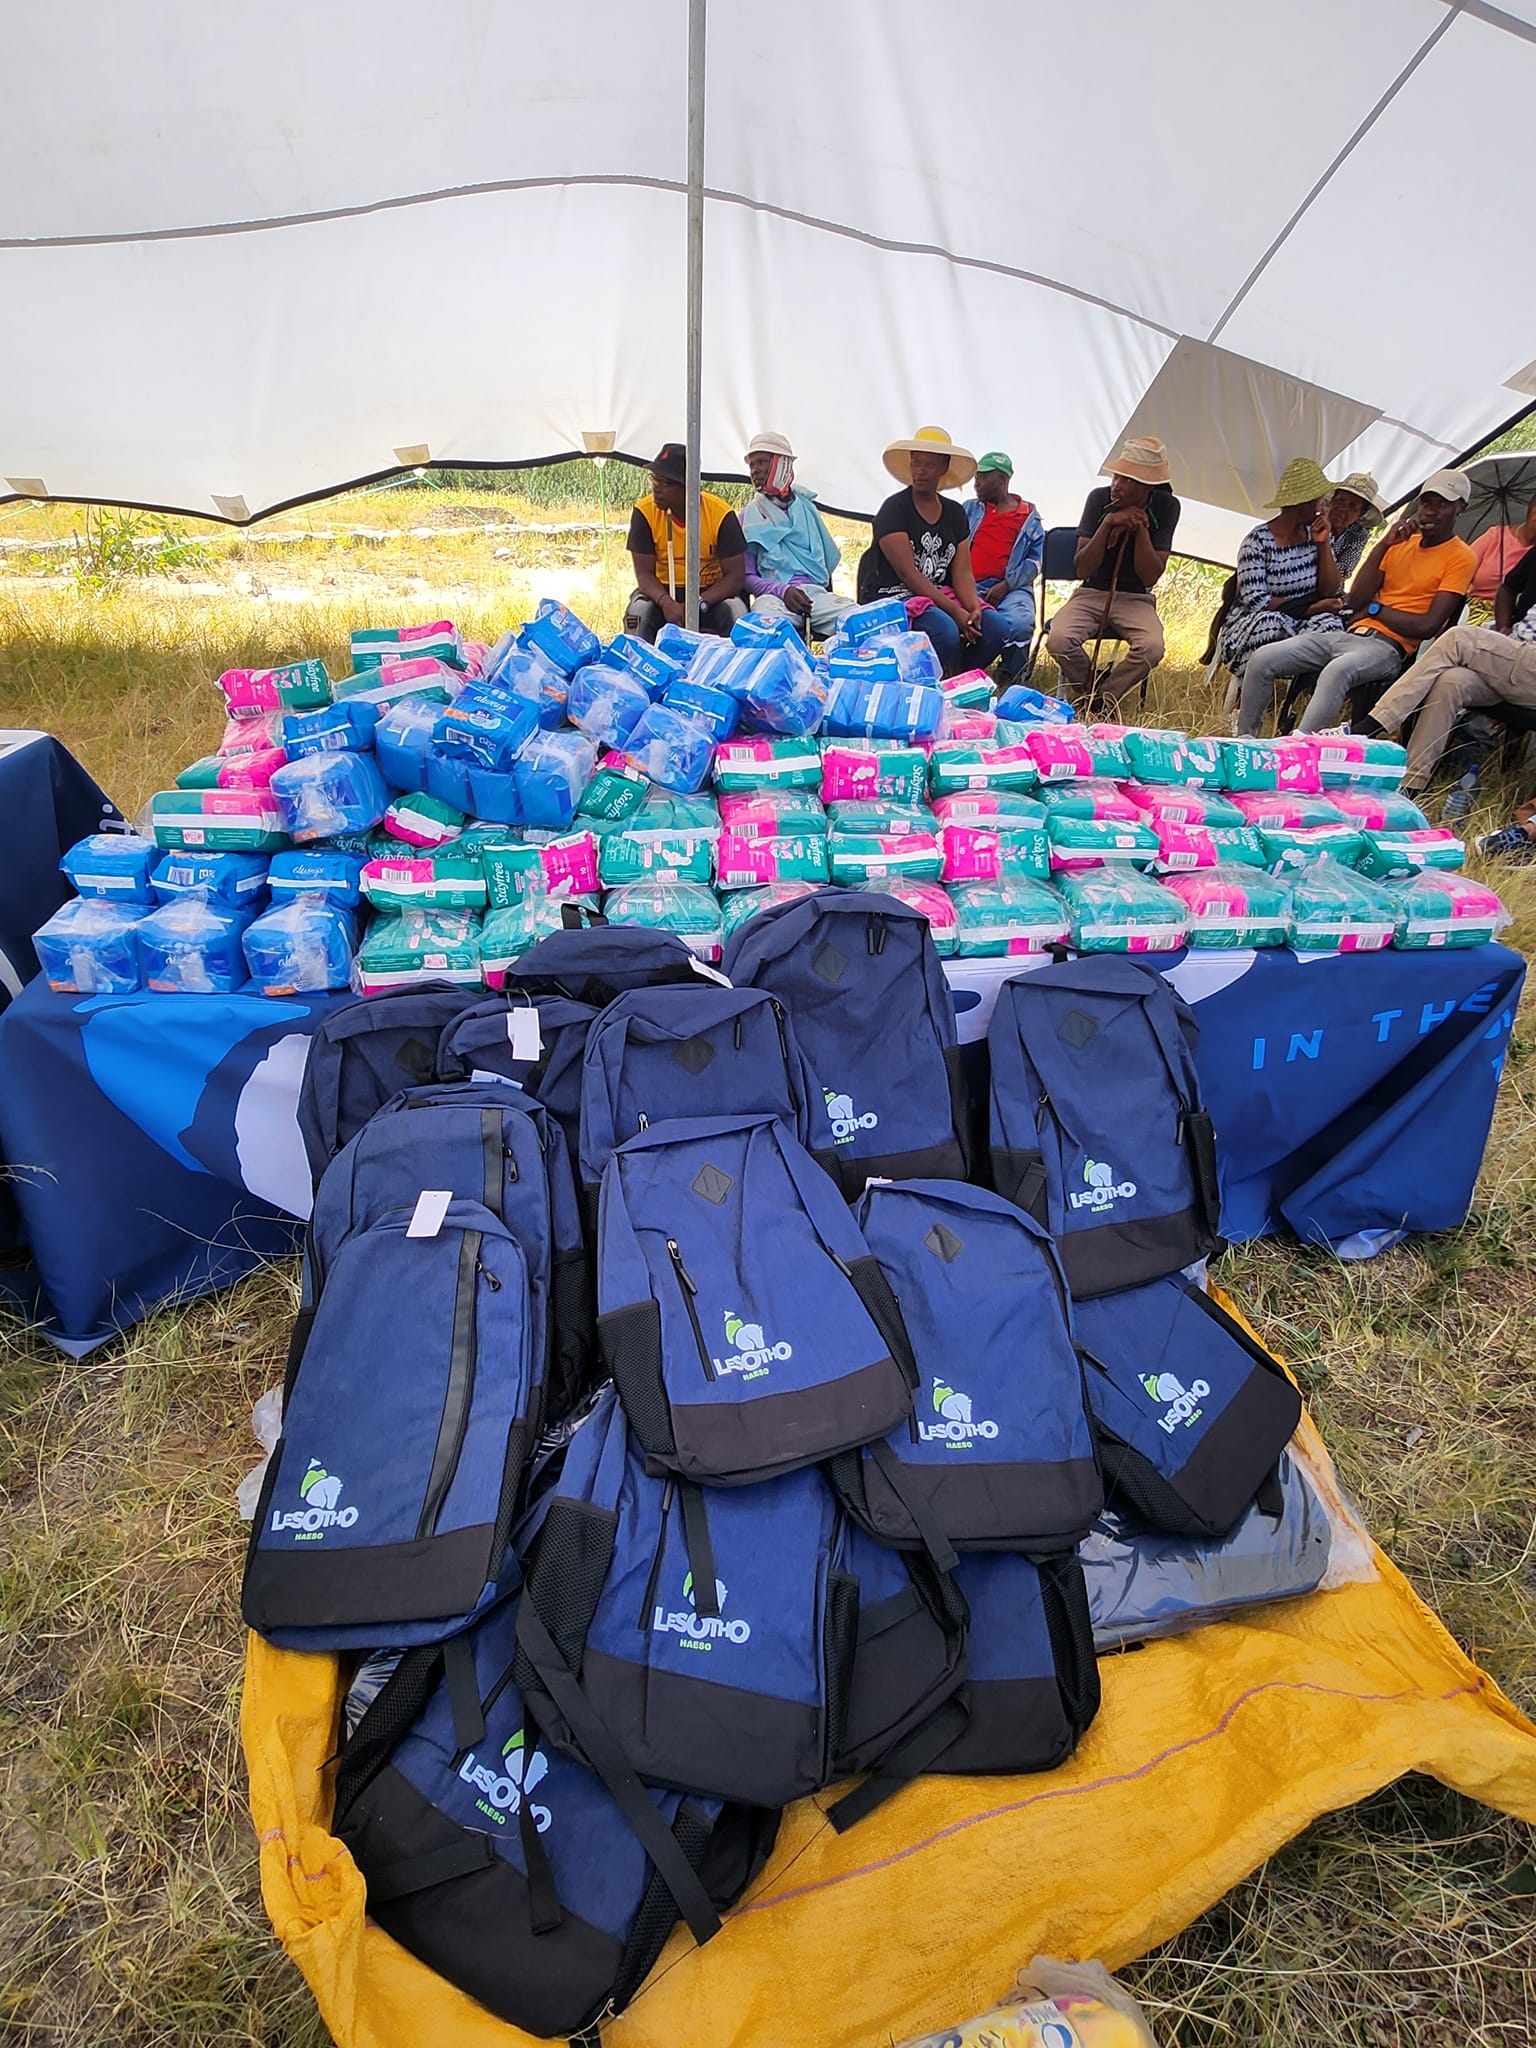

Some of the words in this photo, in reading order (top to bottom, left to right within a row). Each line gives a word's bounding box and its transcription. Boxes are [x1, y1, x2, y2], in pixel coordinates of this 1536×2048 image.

[473, 695, 508, 711] always
[292, 863, 324, 876] always
[494, 862, 509, 905] Stayfree
[1253, 1029, 1323, 1070] IN
[831, 1112, 878, 1137] OTHO
[1070, 1182, 1137, 1208] LESOTHO
[713, 1341, 792, 1376] LESOTHO
[1157, 1379, 1210, 1434] LESOTHO
[918, 1421, 998, 1441] LESOTHO
[271, 1506, 359, 1531] LESOTHO
[295, 1532, 324, 1541] HAESO
[653, 1606, 751, 1644] LESOTHO
[680, 1639, 712, 1651] HAESO
[459, 1753, 552, 1833] LESOTO
[475, 1799, 506, 1825] HAESO
